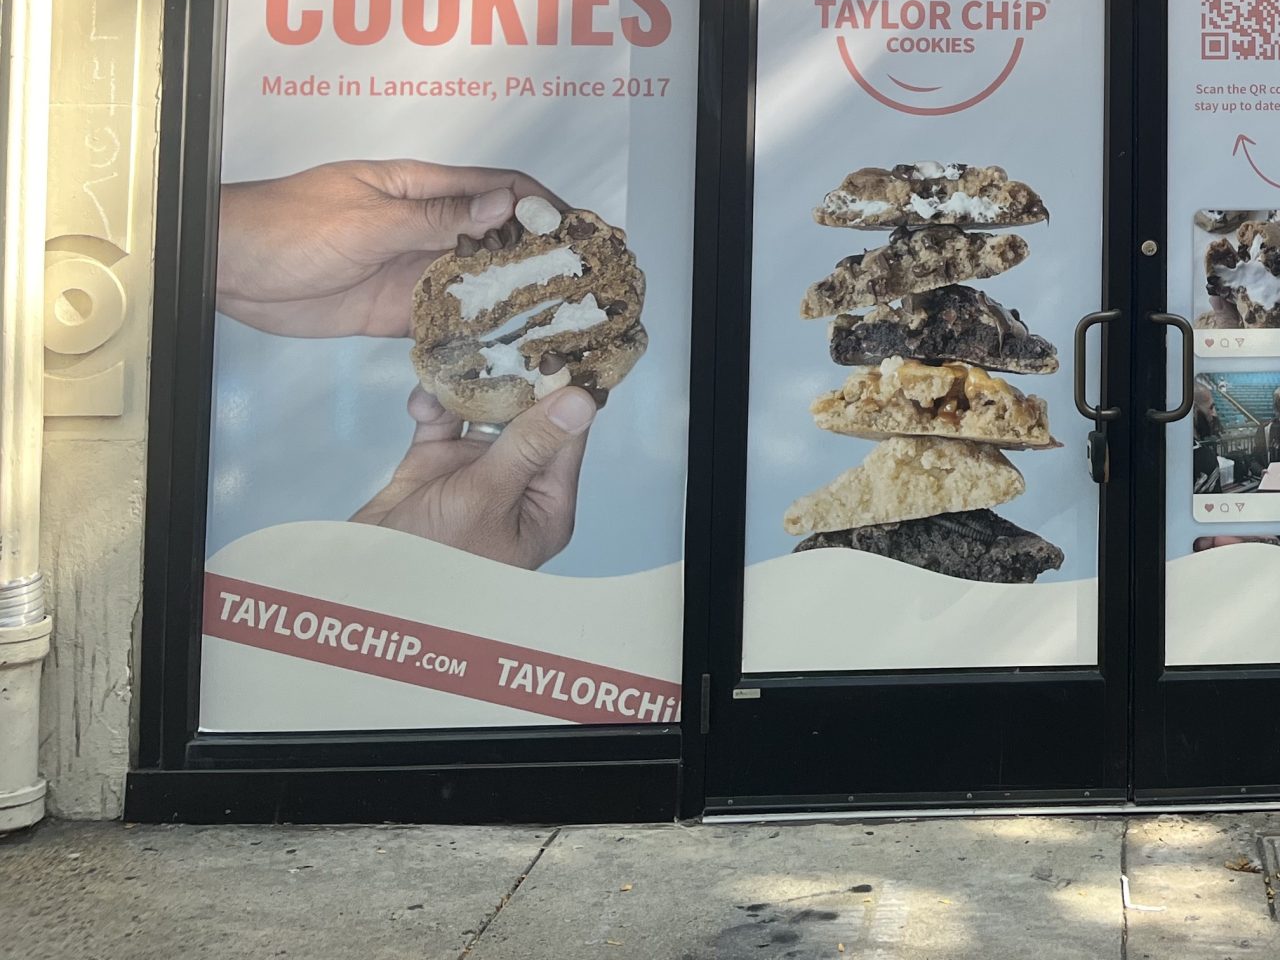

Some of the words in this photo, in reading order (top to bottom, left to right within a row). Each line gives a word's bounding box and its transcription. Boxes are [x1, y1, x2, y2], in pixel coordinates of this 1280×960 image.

[814, 0, 952, 30] TAYLOR
[886, 37, 975, 53] COOKIES
[261, 75, 331, 97] Made
[338, 76, 360, 97] in
[369, 75, 498, 102] Lancaster,
[505, 77, 536, 97] PA
[542, 75, 605, 97] since
[612, 78, 671, 97] 2017
[1195, 84, 1224, 95] Scan
[1227, 84, 1247, 95] the
[1249, 84, 1267, 96] QR
[1194, 101, 1219, 113] stay
[1222, 103, 1237, 113] up
[1240, 101, 1252, 111] to
[1255, 101, 1280, 111] date
